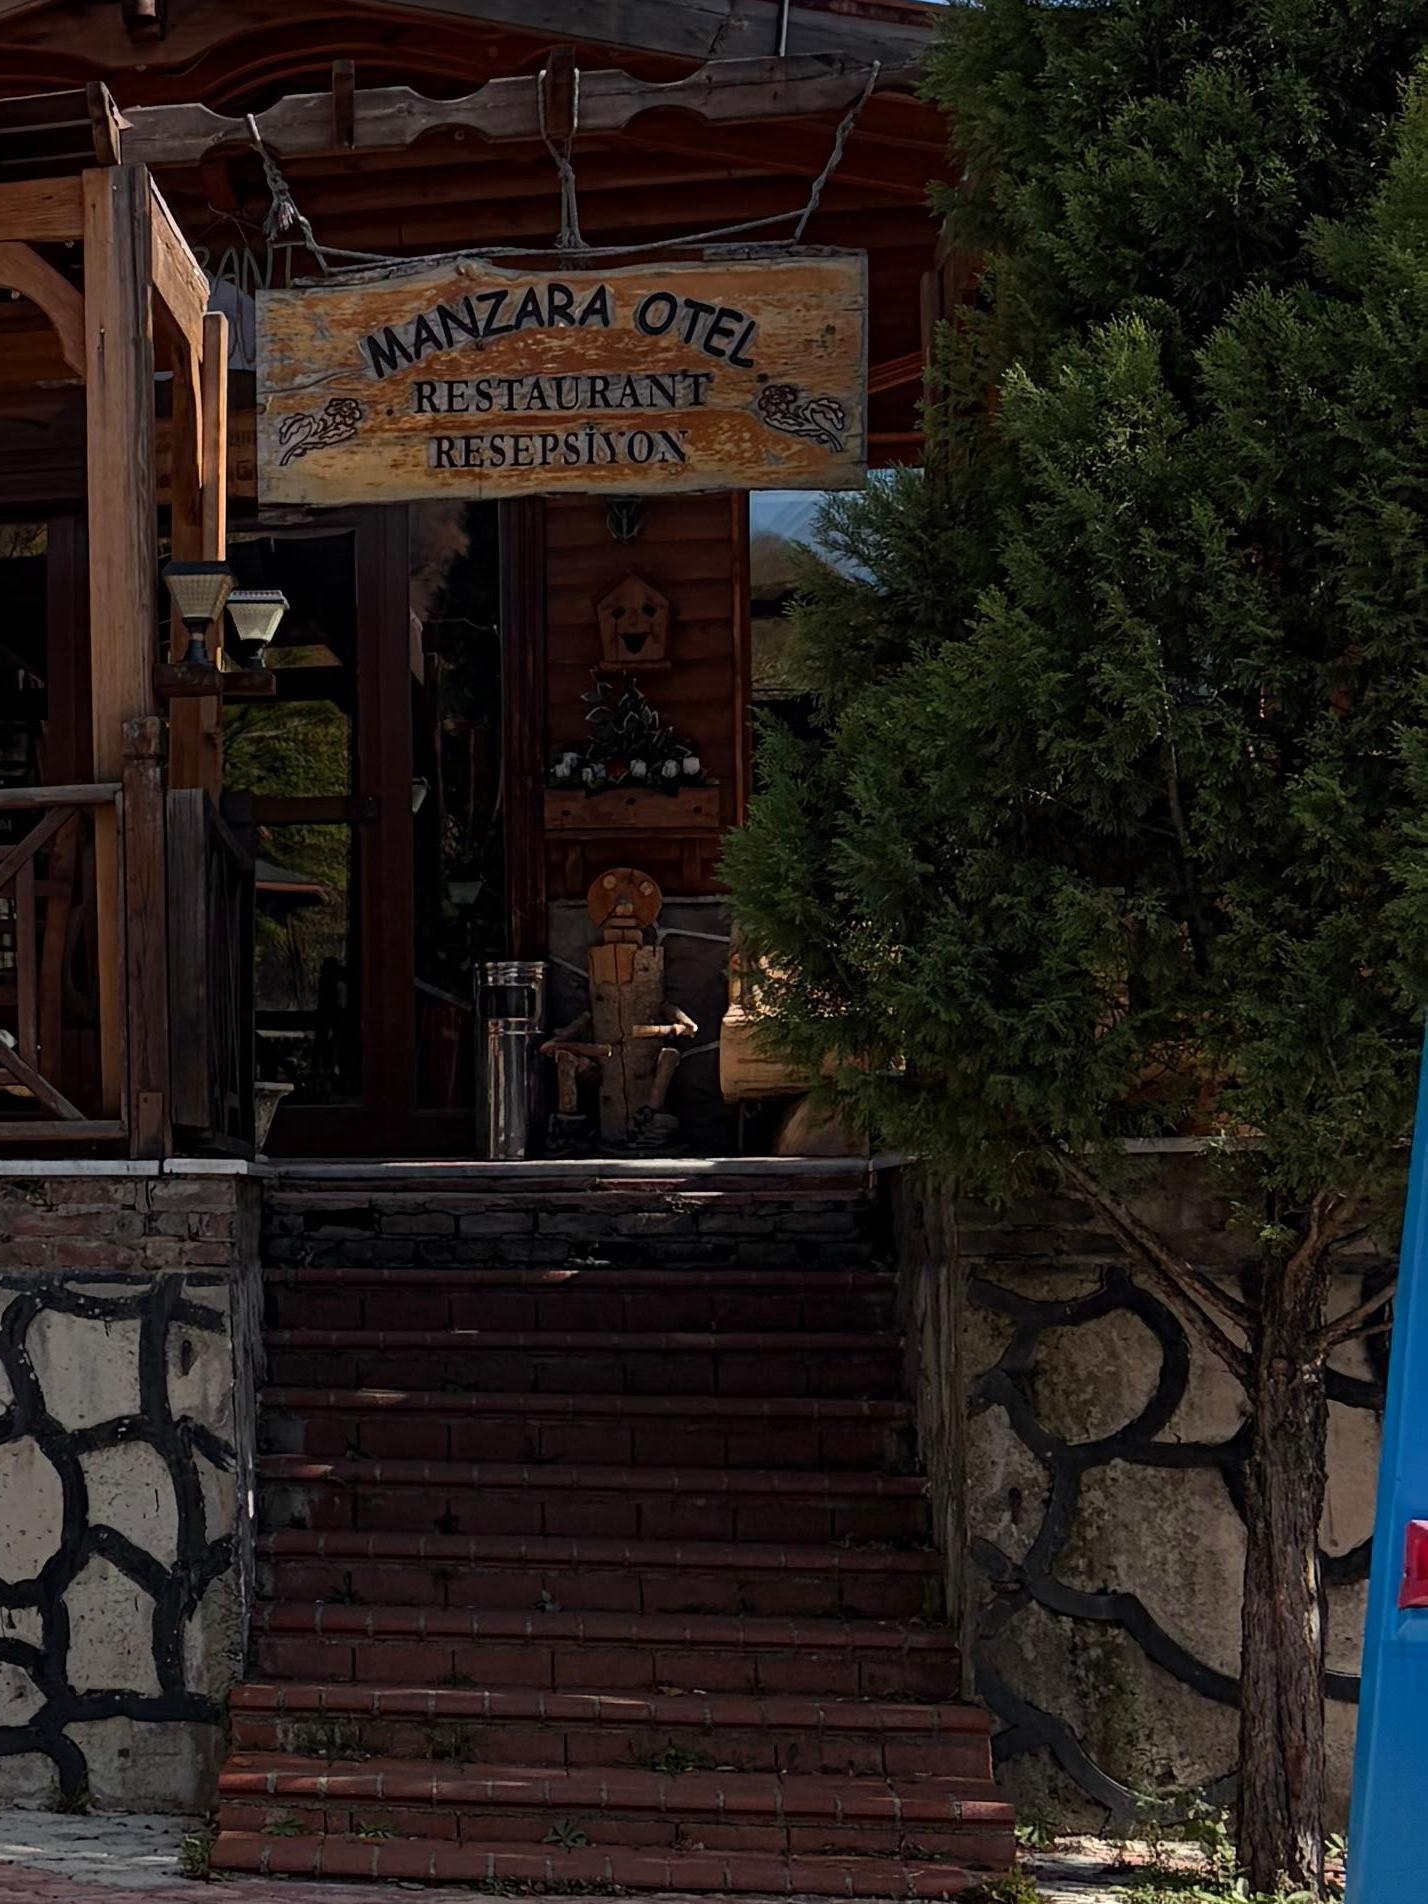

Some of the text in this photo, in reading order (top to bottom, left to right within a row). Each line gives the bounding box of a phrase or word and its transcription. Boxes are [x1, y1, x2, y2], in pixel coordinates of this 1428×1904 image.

[366, 283, 756, 378] MANZARA OTEL
[414, 373, 711, 414] RESTAURANT
[433, 424, 690, 469] RESEPSİYON
